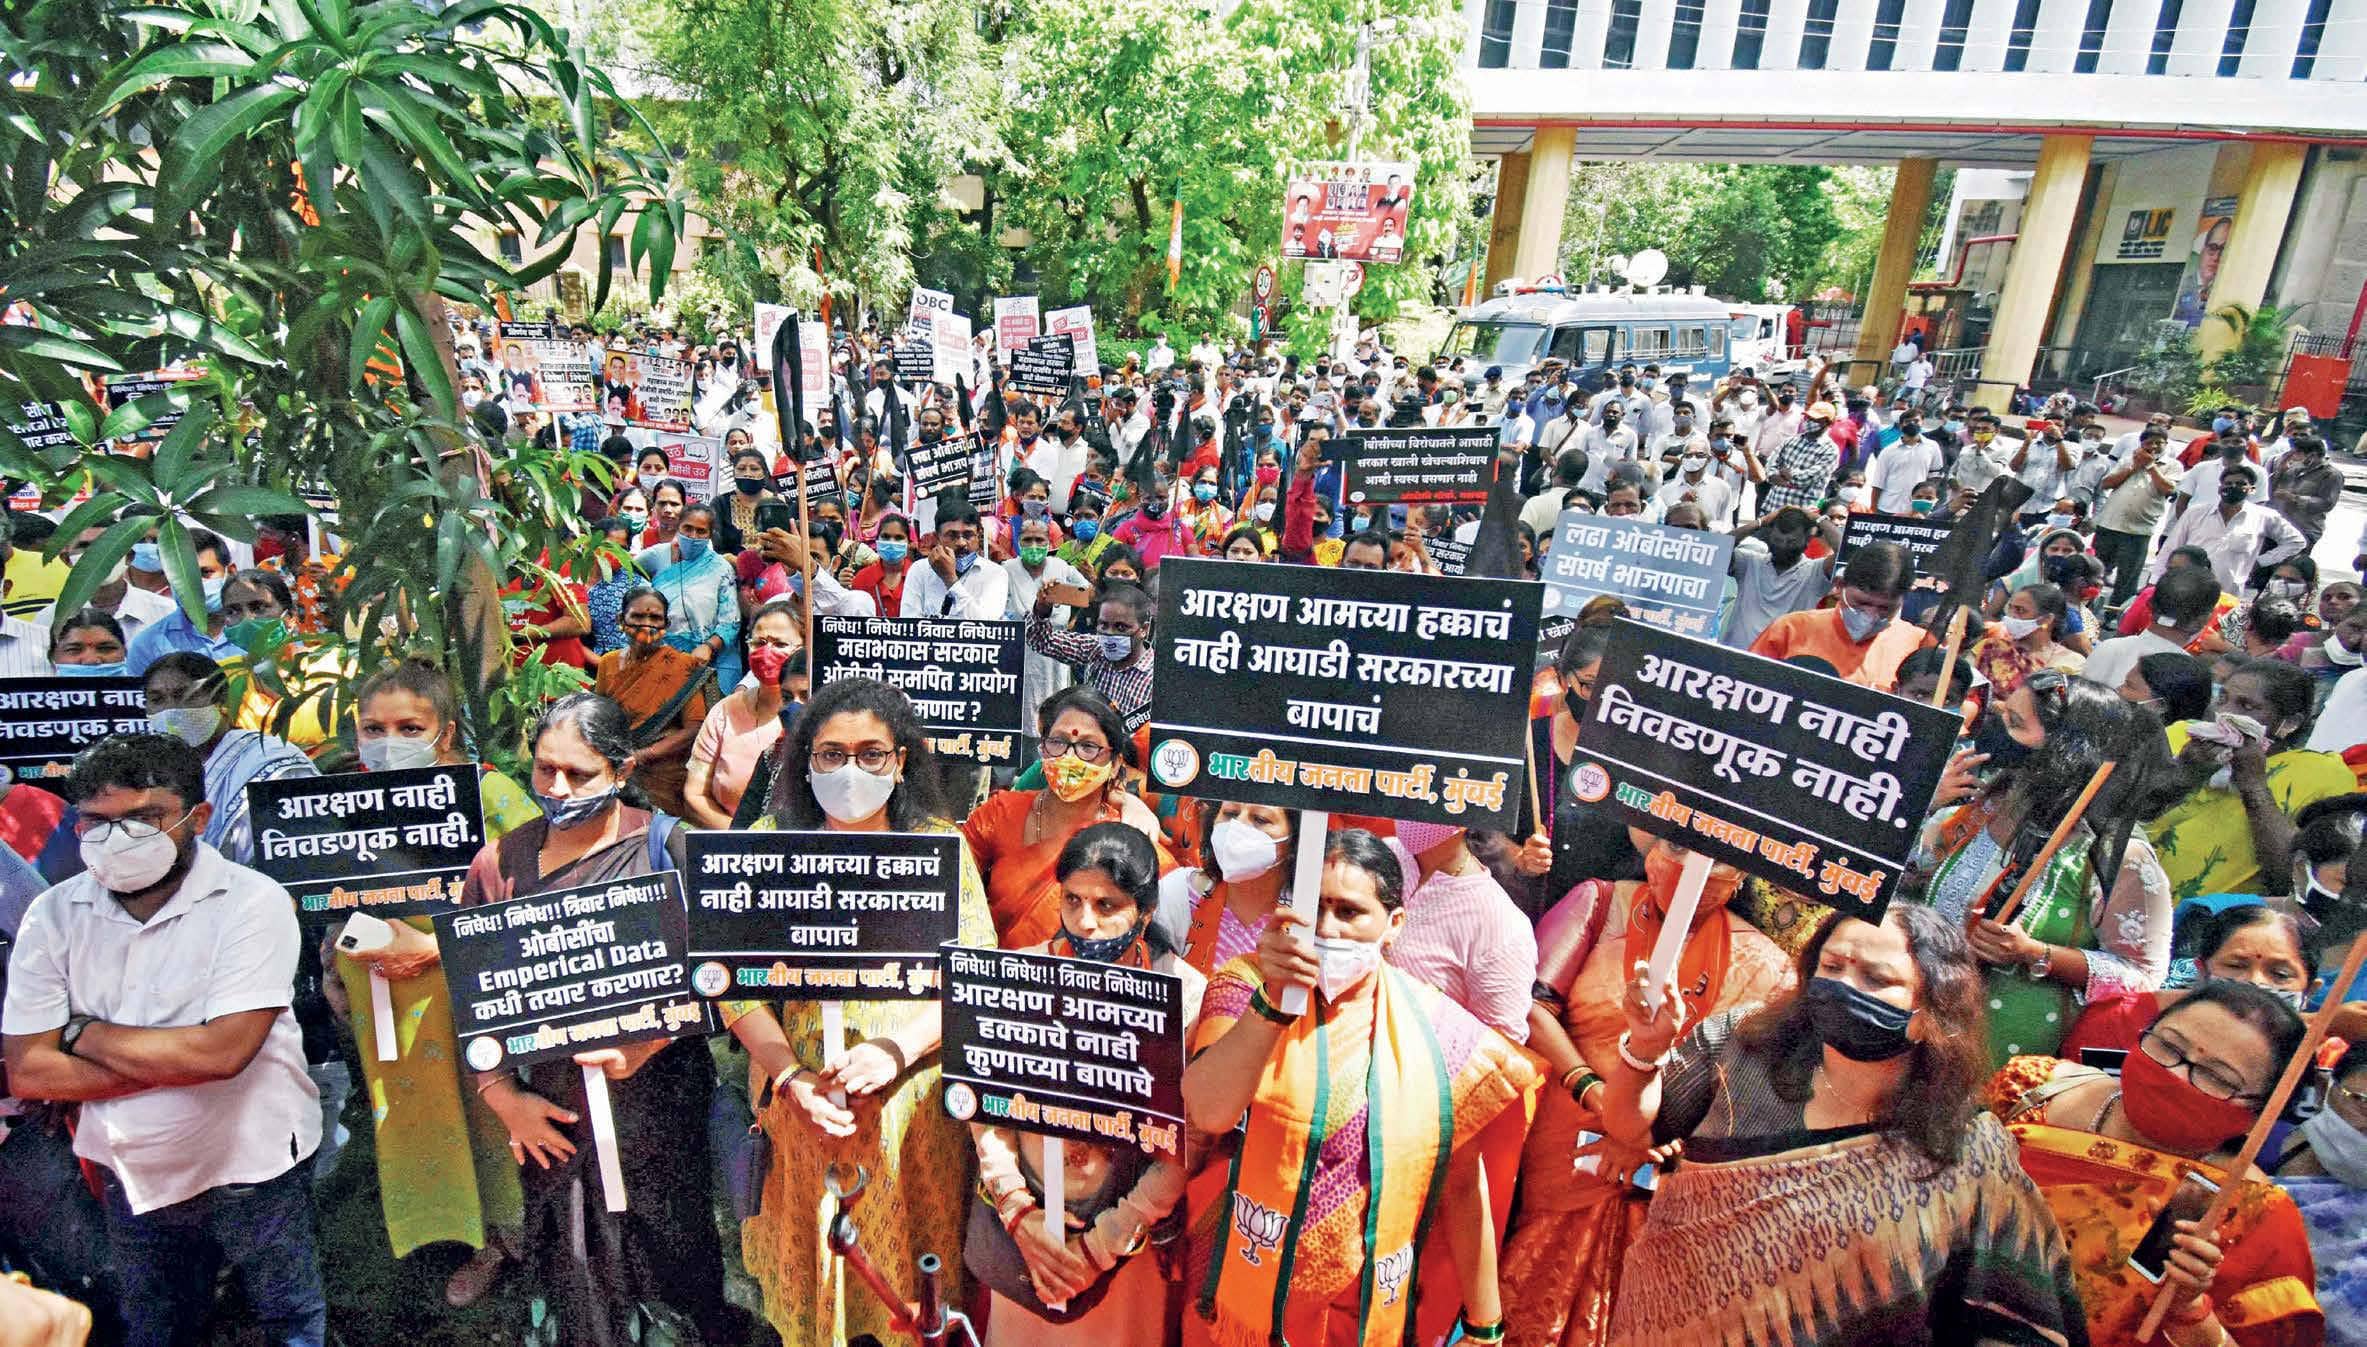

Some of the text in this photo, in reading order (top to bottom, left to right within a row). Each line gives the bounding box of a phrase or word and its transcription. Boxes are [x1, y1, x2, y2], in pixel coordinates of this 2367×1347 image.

[2146, 209, 2173, 236] LIC
[917, 294, 949, 311] OBC
[1364, 436, 1406, 450] बीसीच्या
[1565, 523, 1719, 566] लढा ओबीसींचा
[1444, 562, 1466, 575] आयो
[1556, 551, 1712, 600] संघर्ष भाजपाचा
[1180, 588, 1290, 625] आरक्षण
[1296, 596, 1411, 632] आमच्या
[933, 643, 1002, 664] सरकार
[1174, 630, 1515, 695] नाही आघाडी सरकारच्या
[101, 690, 147, 709] नाह
[958, 669, 1018, 695] आयोग
[971, 702, 981, 722] ?
[1287, 694, 1383, 735] बापाचं
[1635, 653, 1911, 763] आरक्षण नाही
[0, 718, 108, 744] नवडणूक
[1595, 683, 1908, 829] निवडणूक नाही.
[278, 774, 456, 819] आरक्षण नाही
[1208, 748, 1297, 785] भारतीय
[1299, 761, 1371, 794] जनता
[1442, 767, 1508, 815] मुंबई
[261, 812, 478, 862] निवडणूक नाही.
[1615, 781, 1691, 829] भारतीय
[1692, 809, 1758, 854] जनता
[1819, 856, 1886, 903] मुंबई
[701, 853, 784, 877] आरक्षण
[789, 854, 871, 875] आमच्या
[302, 886, 358, 911] भारतीय
[359, 887, 406, 905] जनता
[700, 881, 945, 912] नाही आघाडी सरकारच्या
[519, 919, 616, 958] ओबीसींचा
[789, 917, 860, 947] बापाचं
[478, 939, 667, 992] Emperical Data
[736, 961, 802, 987] भारतीय
[804, 969, 857, 987] जनता
[472, 963, 684, 1021] कधी तयार करणार?
[951, 981, 1166, 1034] आरक्षण आमच्या
[976, 1016, 1140, 1062] हक्काचे नाही
[963, 1044, 1154, 1098] कुणाच्या बापाचे
[982, 1093, 1041, 1124] भारतीय
[1041, 1104, 1093, 1132] जनता
[1137, 1116, 1178, 1155] मुंबई
